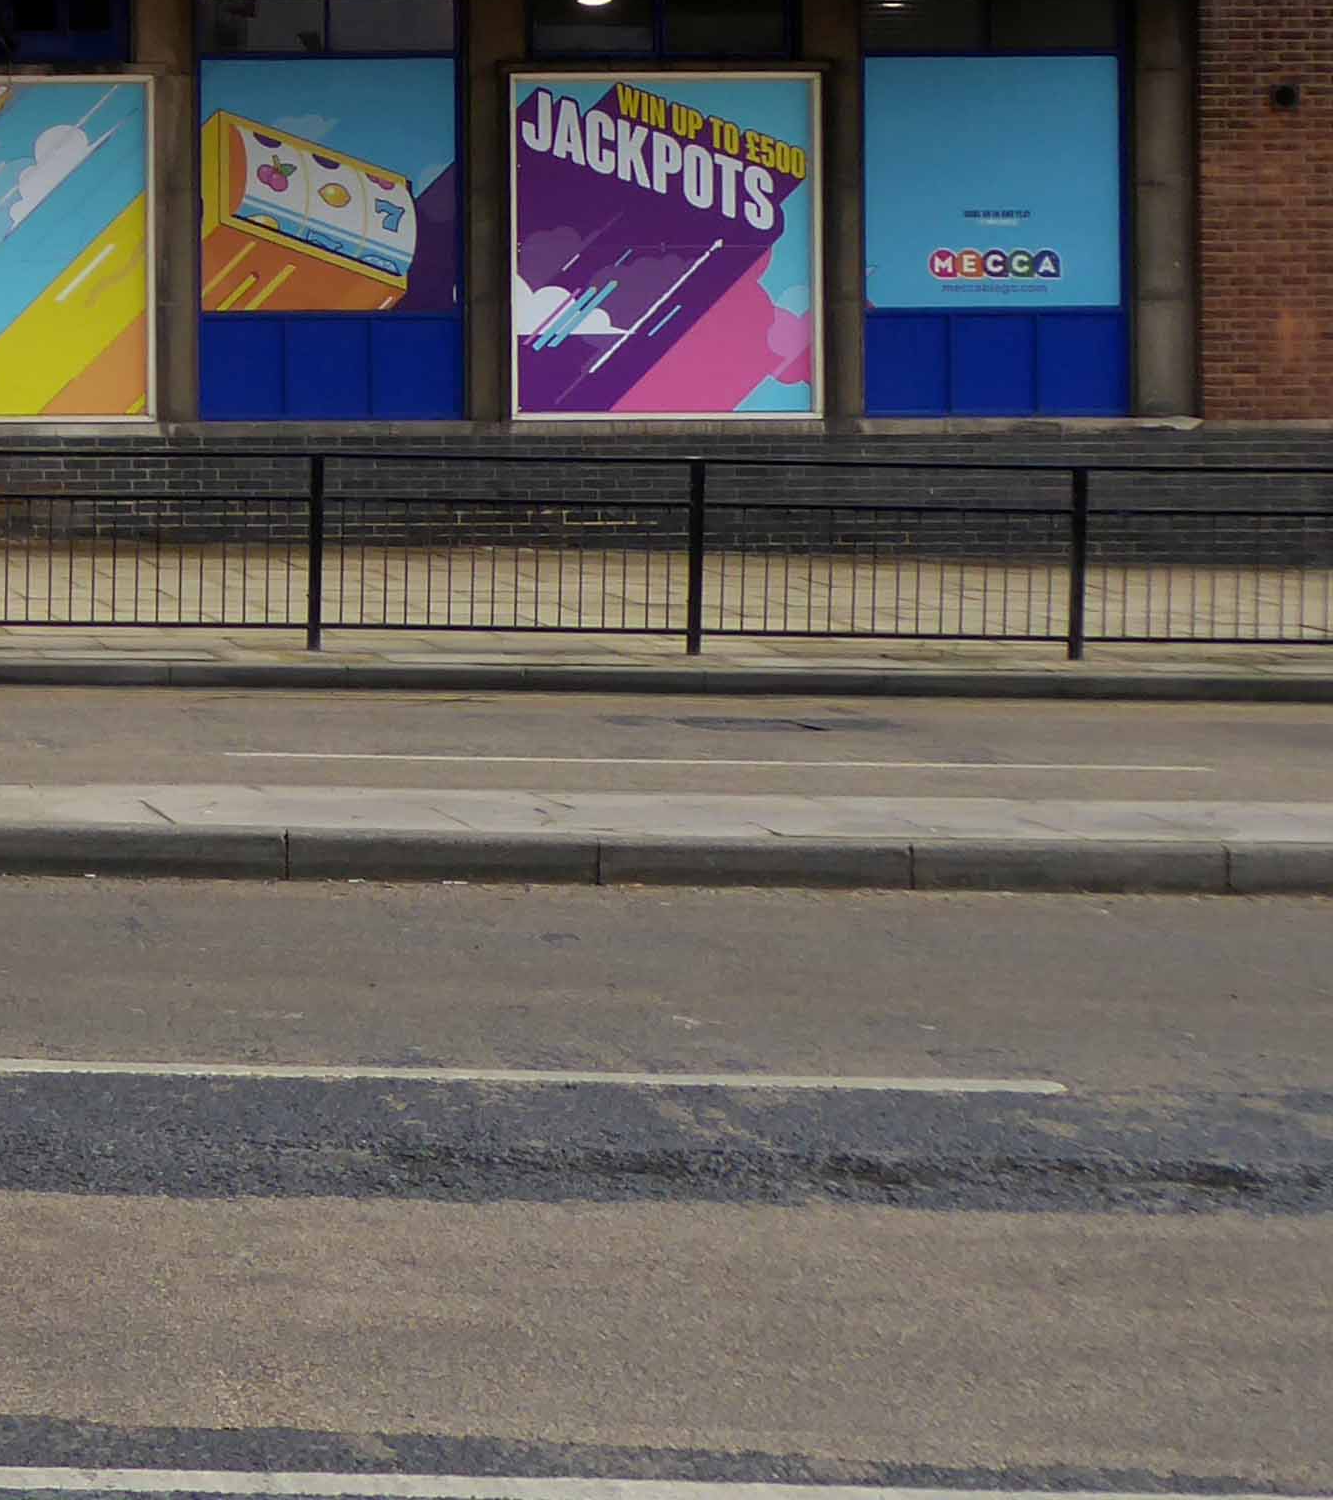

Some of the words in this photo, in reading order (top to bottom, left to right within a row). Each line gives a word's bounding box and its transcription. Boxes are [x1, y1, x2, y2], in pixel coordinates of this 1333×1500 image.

[522, 90, 774, 231] JACKPOTS
[616, 83, 666, 130] WIN
[672, 103, 703, 140] UP
[709, 117, 739, 156] TO
[745, 131, 806, 180] £500
[374, 198, 406, 233] 7
[933, 252, 1057, 275] MECCA
